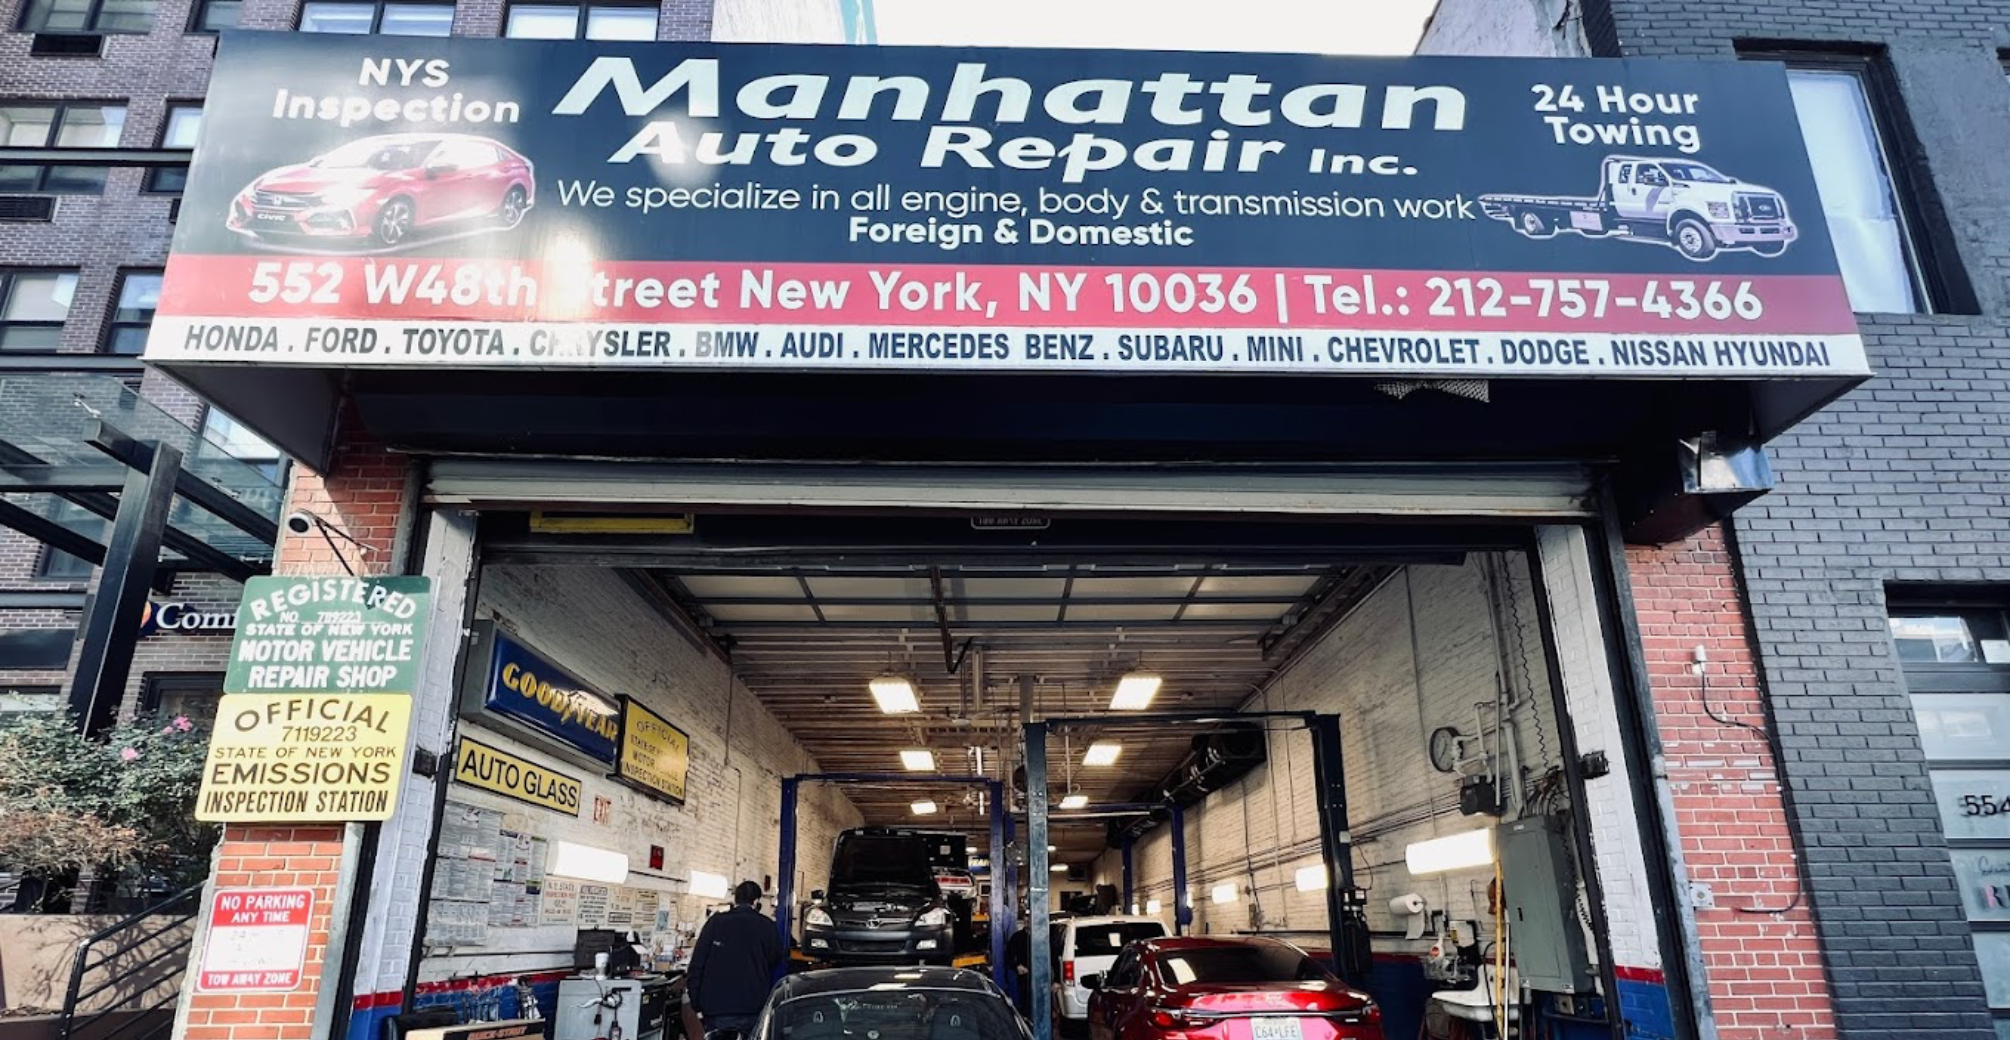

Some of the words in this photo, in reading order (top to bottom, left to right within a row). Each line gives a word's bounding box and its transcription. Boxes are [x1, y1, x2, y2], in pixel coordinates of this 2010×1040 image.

[358, 57, 450, 87] NYS
[272, 88, 519, 128] Inspection
[551, 56, 1466, 131] Manhattan
[1530, 83, 1585, 113] 24
[1596, 84, 1700, 116] Hour
[1543, 115, 1700, 154] Towing
[607, 120, 878, 167] Auto
[920, 126, 1286, 183] Repair
[1308, 148, 1418, 176] Inc.
[557, 179, 615, 209] We
[625, 182, 801, 214] specialize
[812, 184, 840, 211] in
[851, 185, 889, 212] all
[901, 187, 1028, 219] engine,
[1039, 187, 1129, 218] body
[1141, 188, 1164, 215] &
[1173, 190, 1384, 217] transmission
[1394, 193, 1476, 220] work
[849, 217, 982, 250] Foreign
[994, 219, 1019, 244] &
[1030, 219, 1194, 246] Domestic
[248, 262, 345, 304] 552
[364, 265, 538, 306] W48th
[556, 269, 720, 309] treet
[739, 269, 850, 310] New
[869, 271, 998, 319] York,
[1018, 273, 1087, 312] NY
[1105, 273, 1258, 314] 10036
[1304, 274, 1410, 316] Tel.:
[1425, 277, 1763, 320] 212-757-4366
[184, 325, 279, 353] HONDA
[305, 326, 378, 354] FORD
[402, 328, 504, 355] TOYOTA
[695, 330, 759, 357] BMW
[780, 332, 844, 358] AUDI
[868, 332, 1009, 359] MERCEDES
[1025, 333, 1095, 360] BENZ
[1118, 334, 1223, 361] SUBARU
[1247, 335, 1303, 361] MINI
[1327, 336, 1480, 365] CHEVROLET
[1503, 339, 1589, 365] DODGE
[1612, 340, 1708, 366] NISSAN
[1716, 340, 1830, 366] HYUNDAI
[250, 579, 416, 621] REGISTERED
[245, 624, 296, 636] STATE
[301, 624, 325, 636] OF
[327, 624, 366, 636] NEW
[371, 623, 413, 636] YORK
[280, 611, 300, 623] NO.
[238, 639, 315, 662] MOTOR
[322, 639, 414, 662] VEHICLE
[248, 666, 330, 688] REPAIR
[336, 666, 397, 688] SHOP
[234, 698, 390, 733] OFFICIAL
[502, 662, 618, 742] GOODYEAR
[282, 725, 358, 742] 7119223
[214, 747, 267, 758] STATE
[275, 747, 301, 758] OF
[306, 747, 348, 758] NEW
[352, 746, 397, 758] YORK
[211, 763, 390, 784] EMISSIONS
[461, 749, 519, 789] AUTO
[523, 771, 577, 808] GLASS
[204, 790, 308, 813] INSPECTION
[316, 790, 389, 812] STATION
[221, 896, 241, 910] NO
[245, 894, 306, 909] PARKING
[231, 912, 259, 923] ANY
[263, 911, 291, 922] TIME
[207, 974, 230, 985] TOW
[231, 973, 262, 985] AWAY
[263, 972, 293, 985] ZONE
